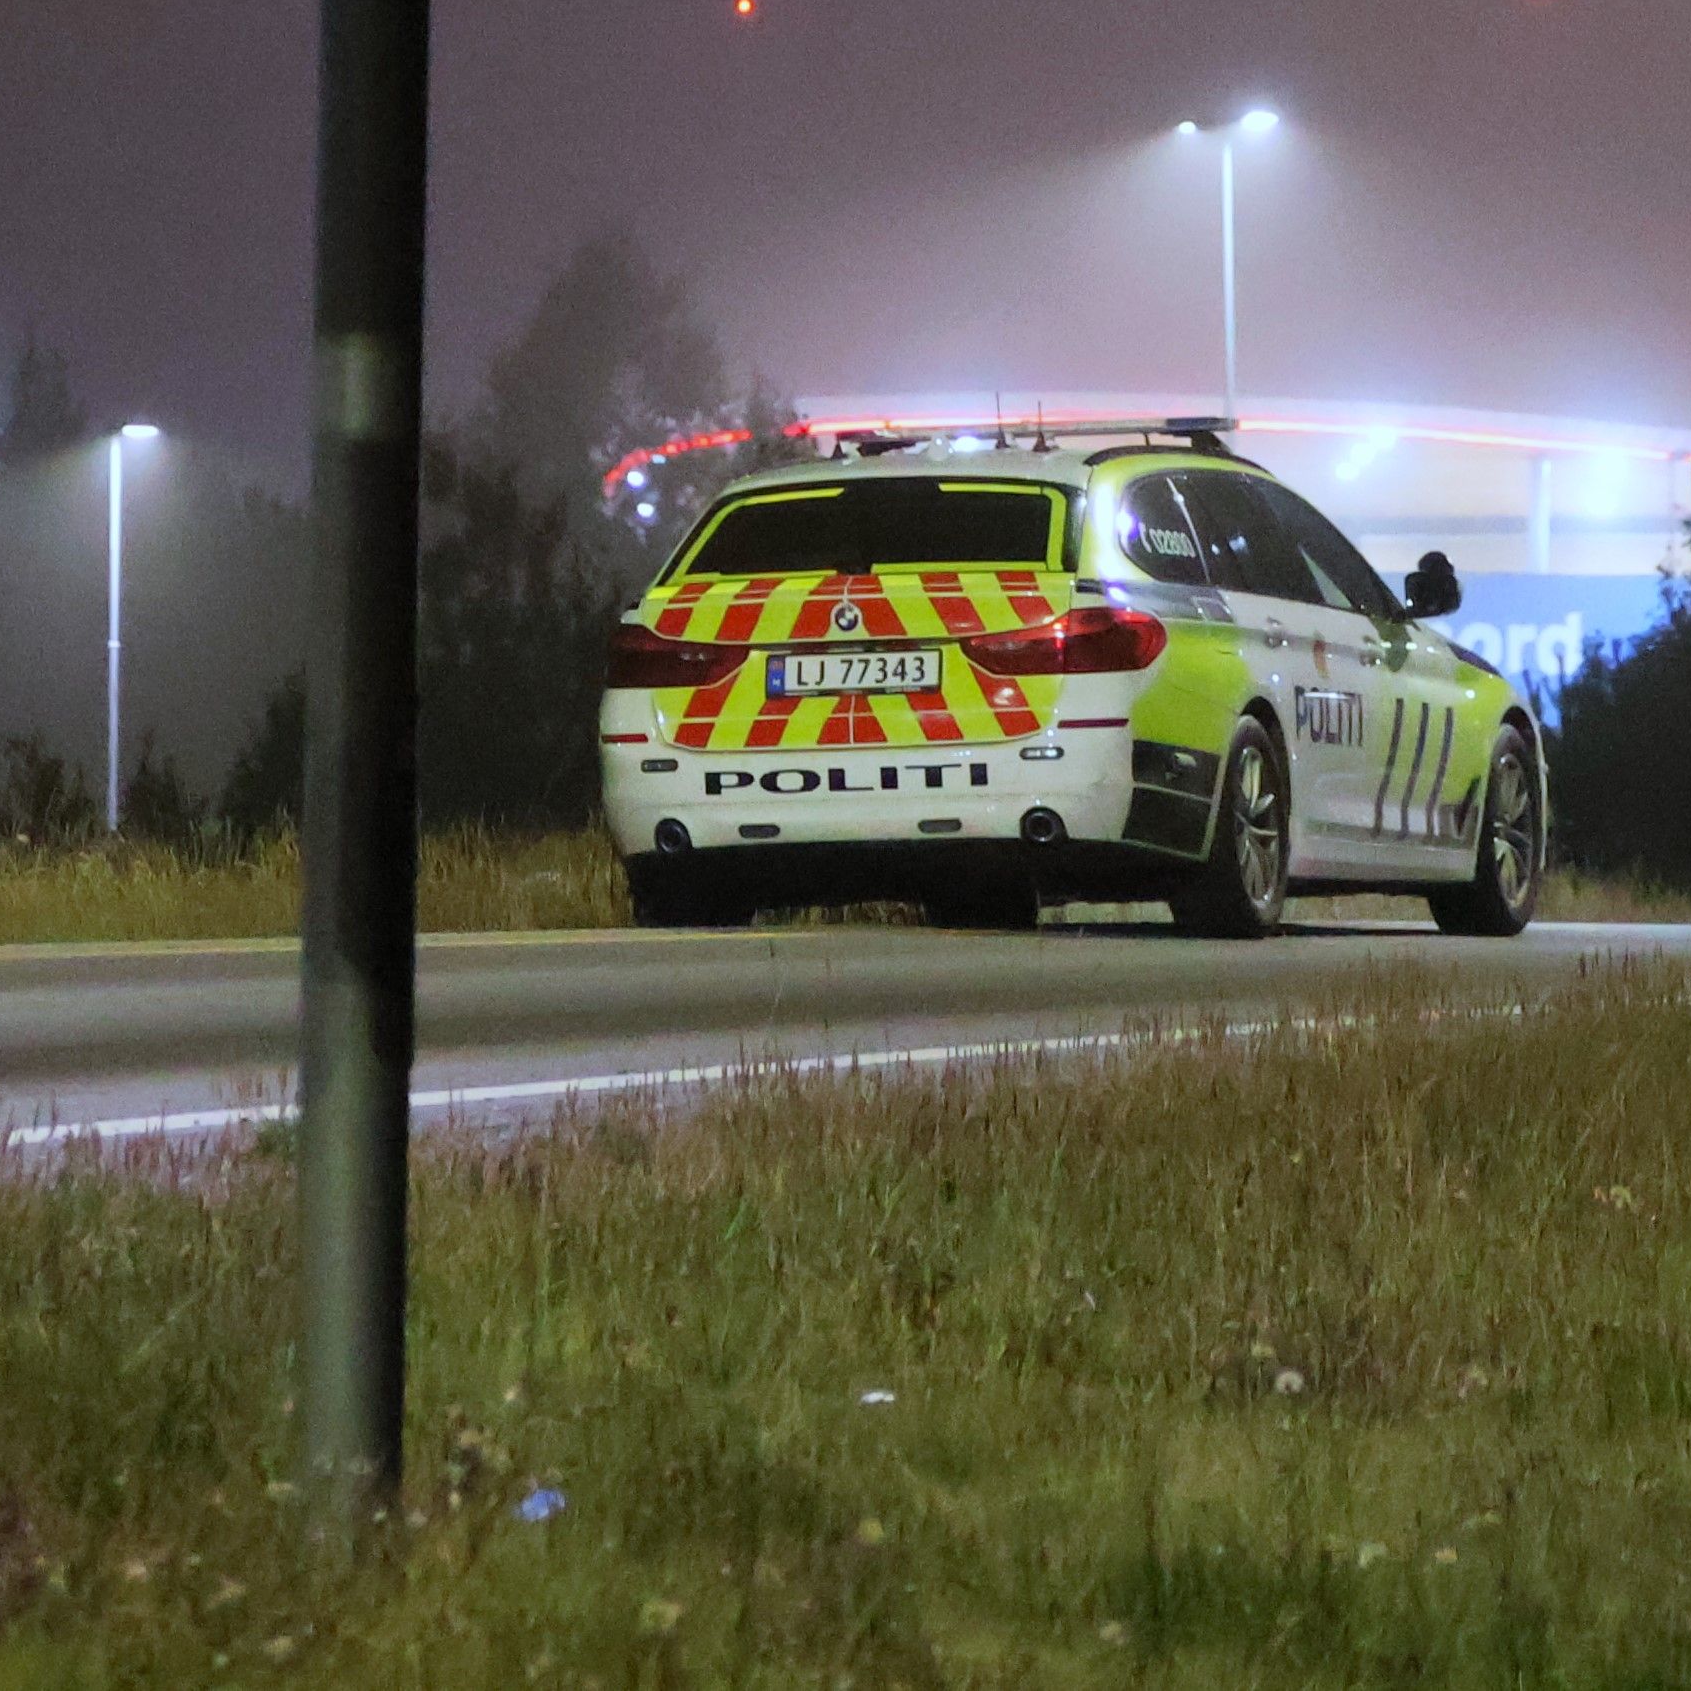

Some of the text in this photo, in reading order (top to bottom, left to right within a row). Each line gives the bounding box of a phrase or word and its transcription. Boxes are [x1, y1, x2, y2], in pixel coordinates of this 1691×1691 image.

[797, 661, 825, 686] LJ
[840, 656, 926, 684] 77343
[1294, 685, 1363, 746] POLITI
[705, 763, 988, 795] POLITI
